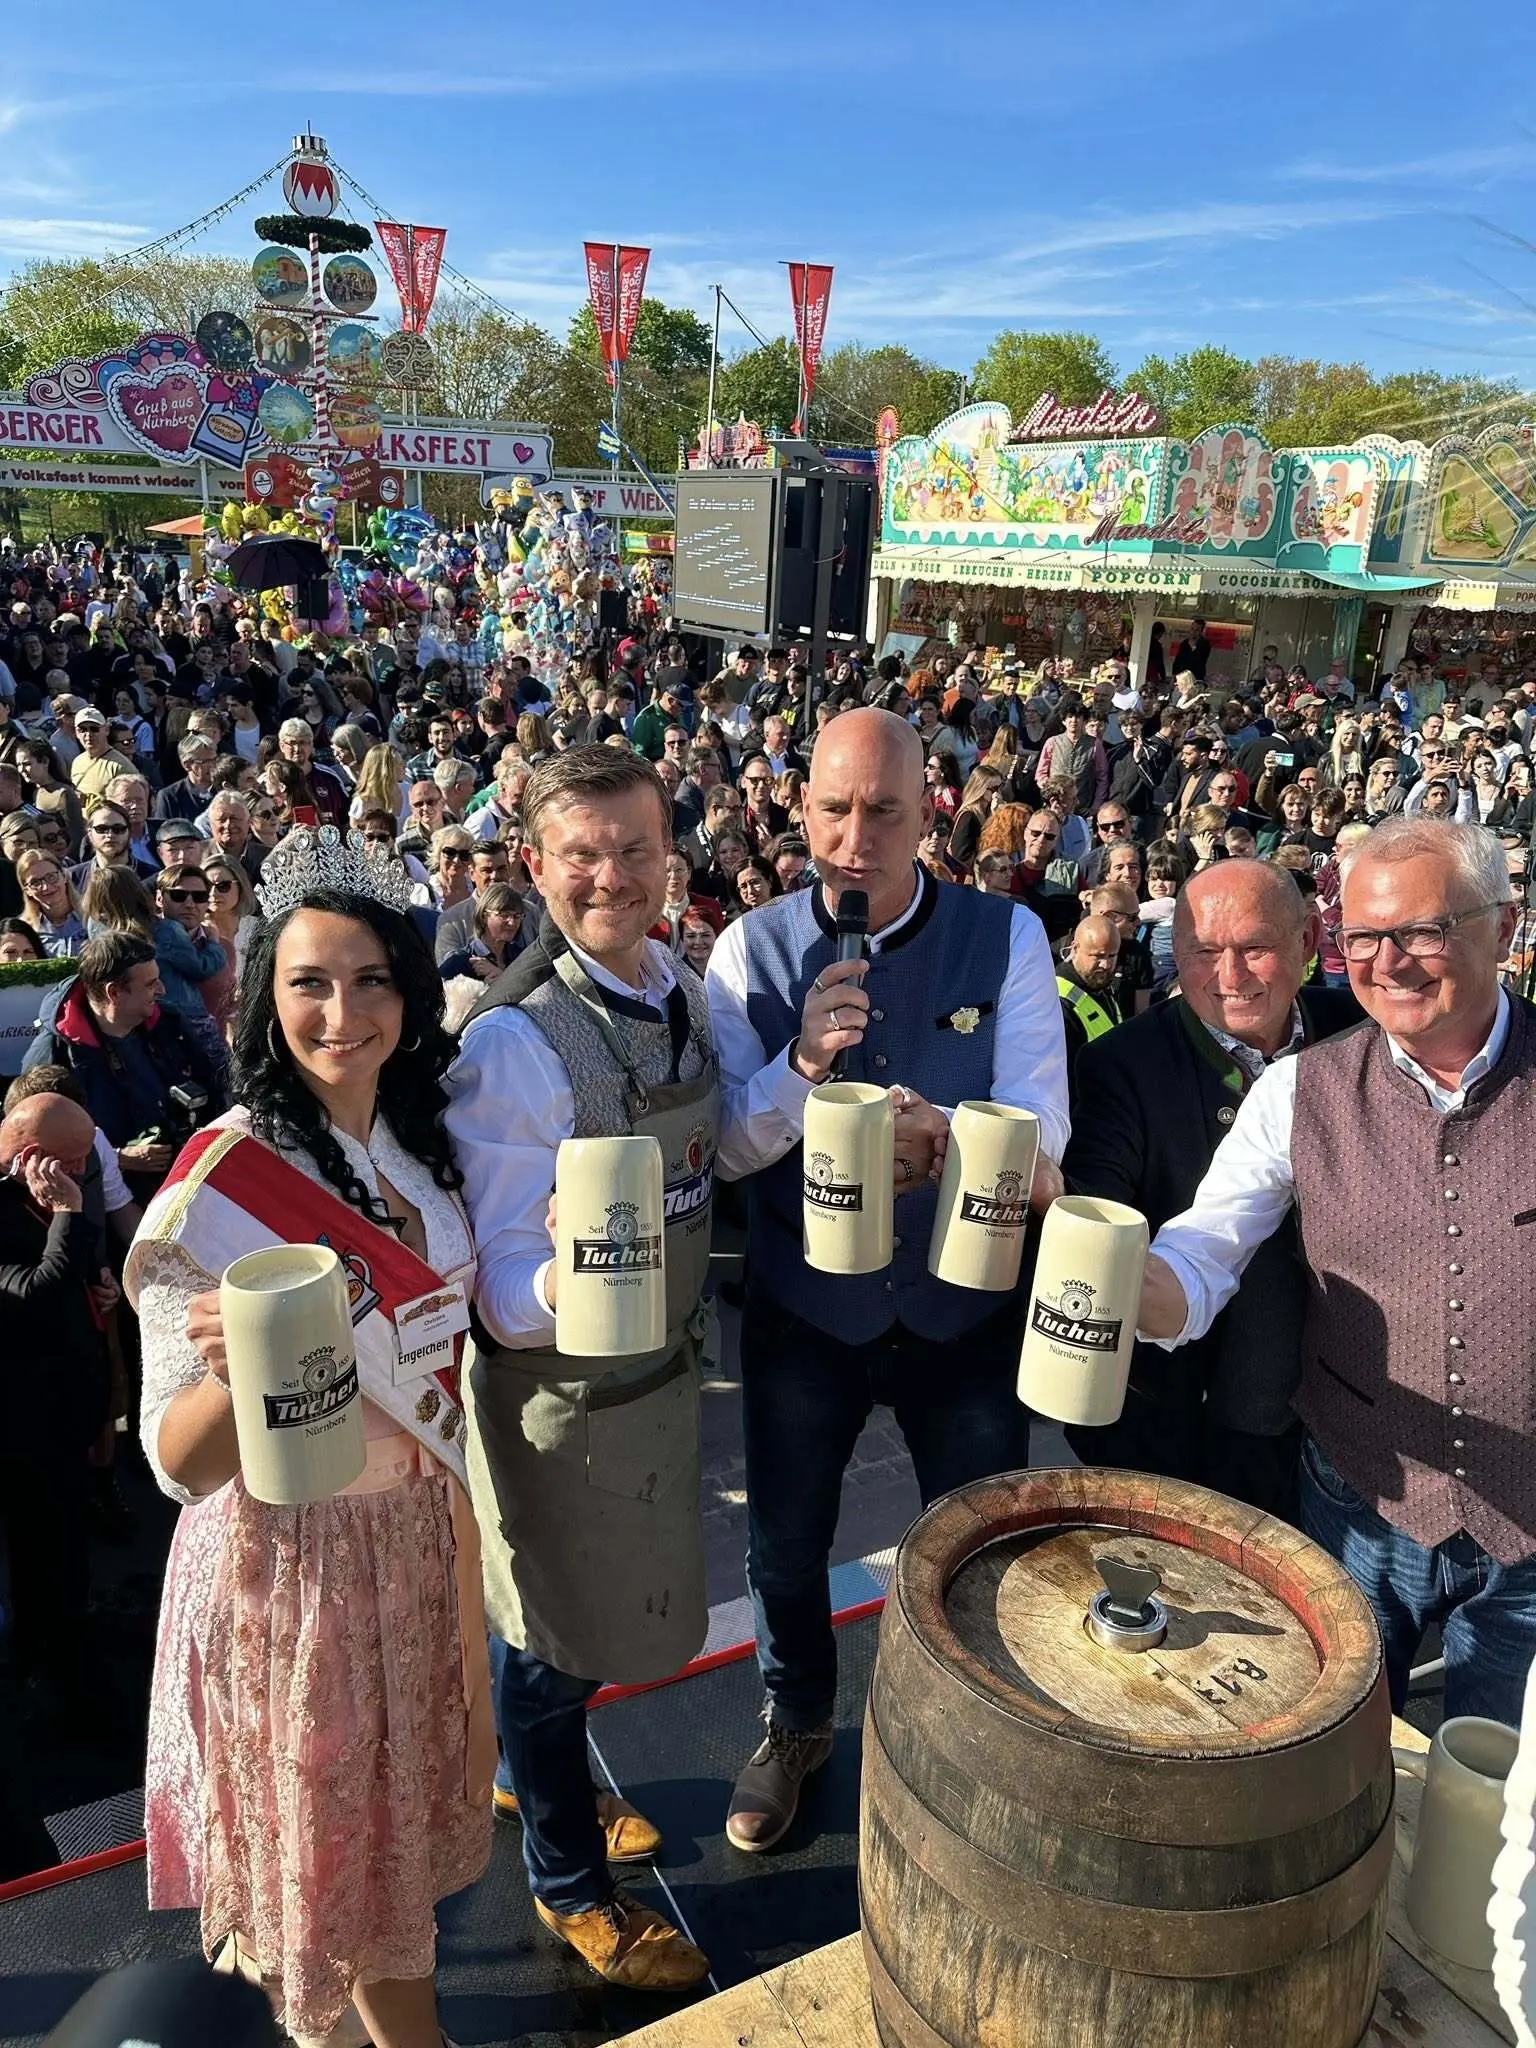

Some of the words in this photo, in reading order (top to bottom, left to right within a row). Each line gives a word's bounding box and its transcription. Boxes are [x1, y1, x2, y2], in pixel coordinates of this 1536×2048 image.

[134, 397, 168, 417] Gruß
[171, 397, 194, 409] aus
[142, 410, 197, 431] Nürnberg
[11, 468, 84, 483] Volksfest
[88, 472, 141, 485] kommt
[144, 475, 196, 487] wieder
[953, 564, 1013, 578] LEBKUCHEN
[1027, 568, 1072, 582] HERZEN
[1091, 571, 1192, 586] POPCORN
[980, 1184, 993, 1193] Seit
[588, 1225, 604, 1234] Seit
[985, 1229, 1016, 1239] Nürnberg
[582, 1246, 658, 1266] Tucher
[603, 1276, 643, 1288] Nürnberg
[1037, 1308, 1113, 1343] Tucher
[1049, 1344, 1089, 1364] Nürnberg
[281, 1379, 300, 1390] Seit
[275, 1375, 356, 1420] Tucher
[305, 1413, 347, 1439] Nürnberg
